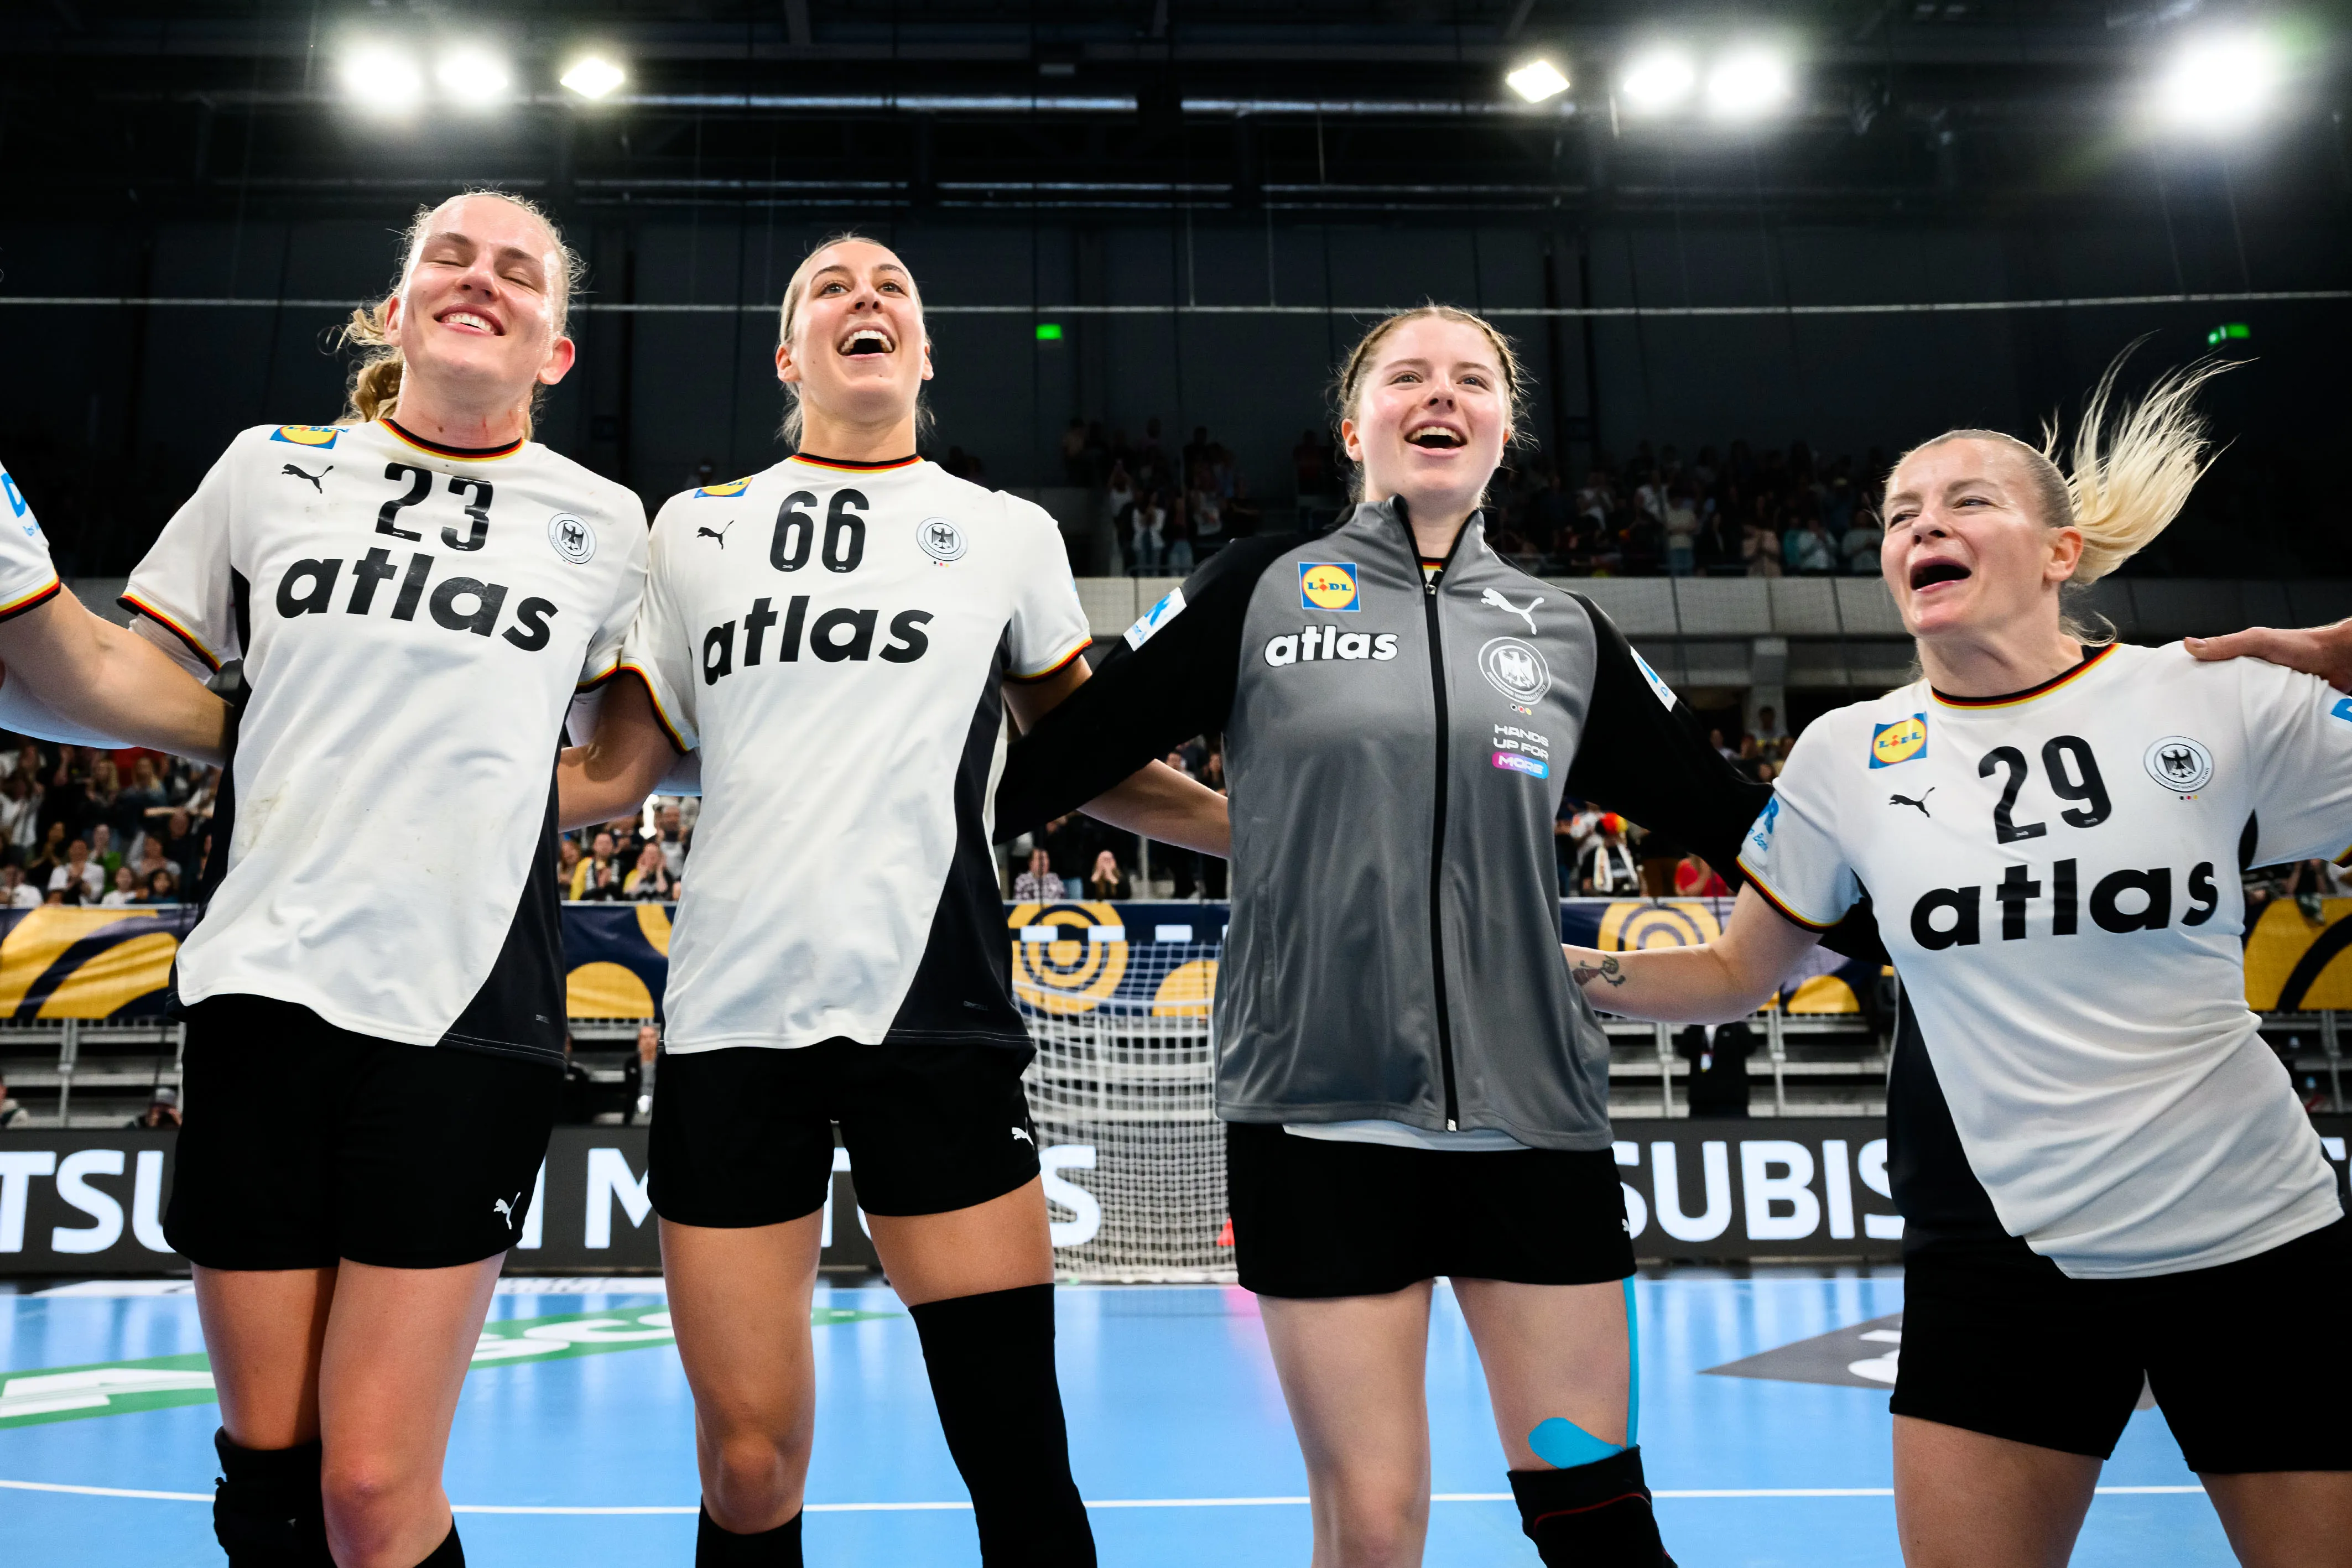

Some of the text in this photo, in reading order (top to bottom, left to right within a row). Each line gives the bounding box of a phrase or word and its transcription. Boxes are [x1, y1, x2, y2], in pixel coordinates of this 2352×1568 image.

[375, 461, 494, 551] 23
[769, 488, 870, 574] 66
[276, 547, 559, 652] atlas
[703, 595, 935, 686] atlas
[1264, 625, 1399, 667] atlas
[1493, 737, 1549, 760] UP FOR
[1494, 723, 1549, 747] HANDS
[1498, 755, 1544, 775] MORE
[1978, 734, 2113, 845] 29
[1909, 858, 2219, 951] atlas
